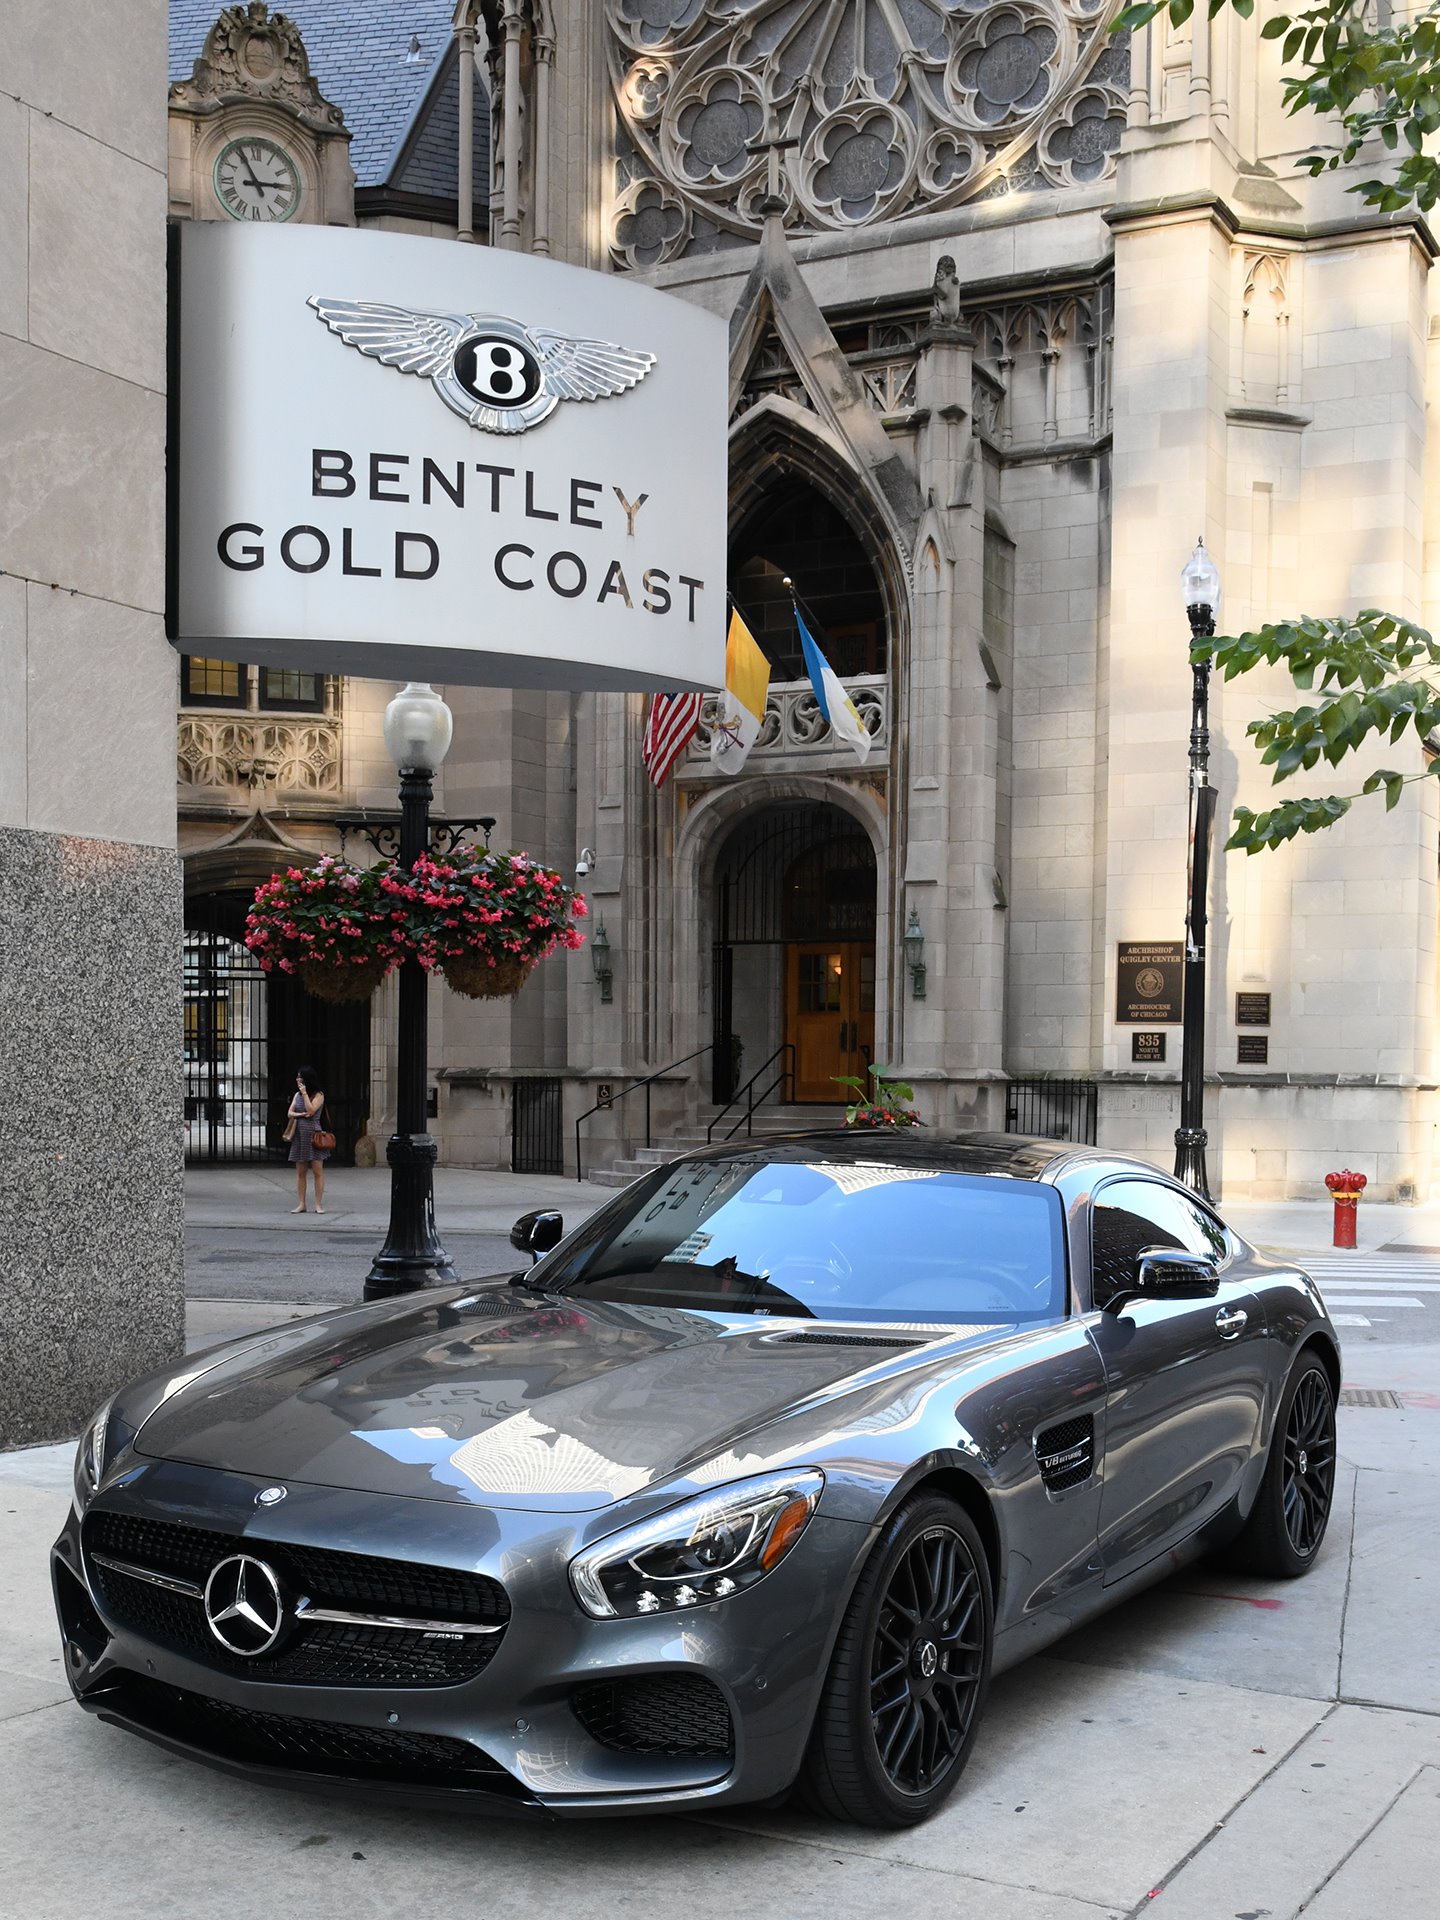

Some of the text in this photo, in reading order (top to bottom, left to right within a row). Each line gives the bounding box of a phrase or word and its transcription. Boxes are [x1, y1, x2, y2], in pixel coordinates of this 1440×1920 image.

[312, 448, 649, 537] BENTLEY
[217, 522, 705, 622] GOLD COAST
[1127, 946, 1174, 954] ARCHBISHOP
[1119, 955, 1181, 964] QUIGLEY CENTER
[1138, 1034, 1160, 1047] 835
[1045, 1456, 1059, 1468] V8
